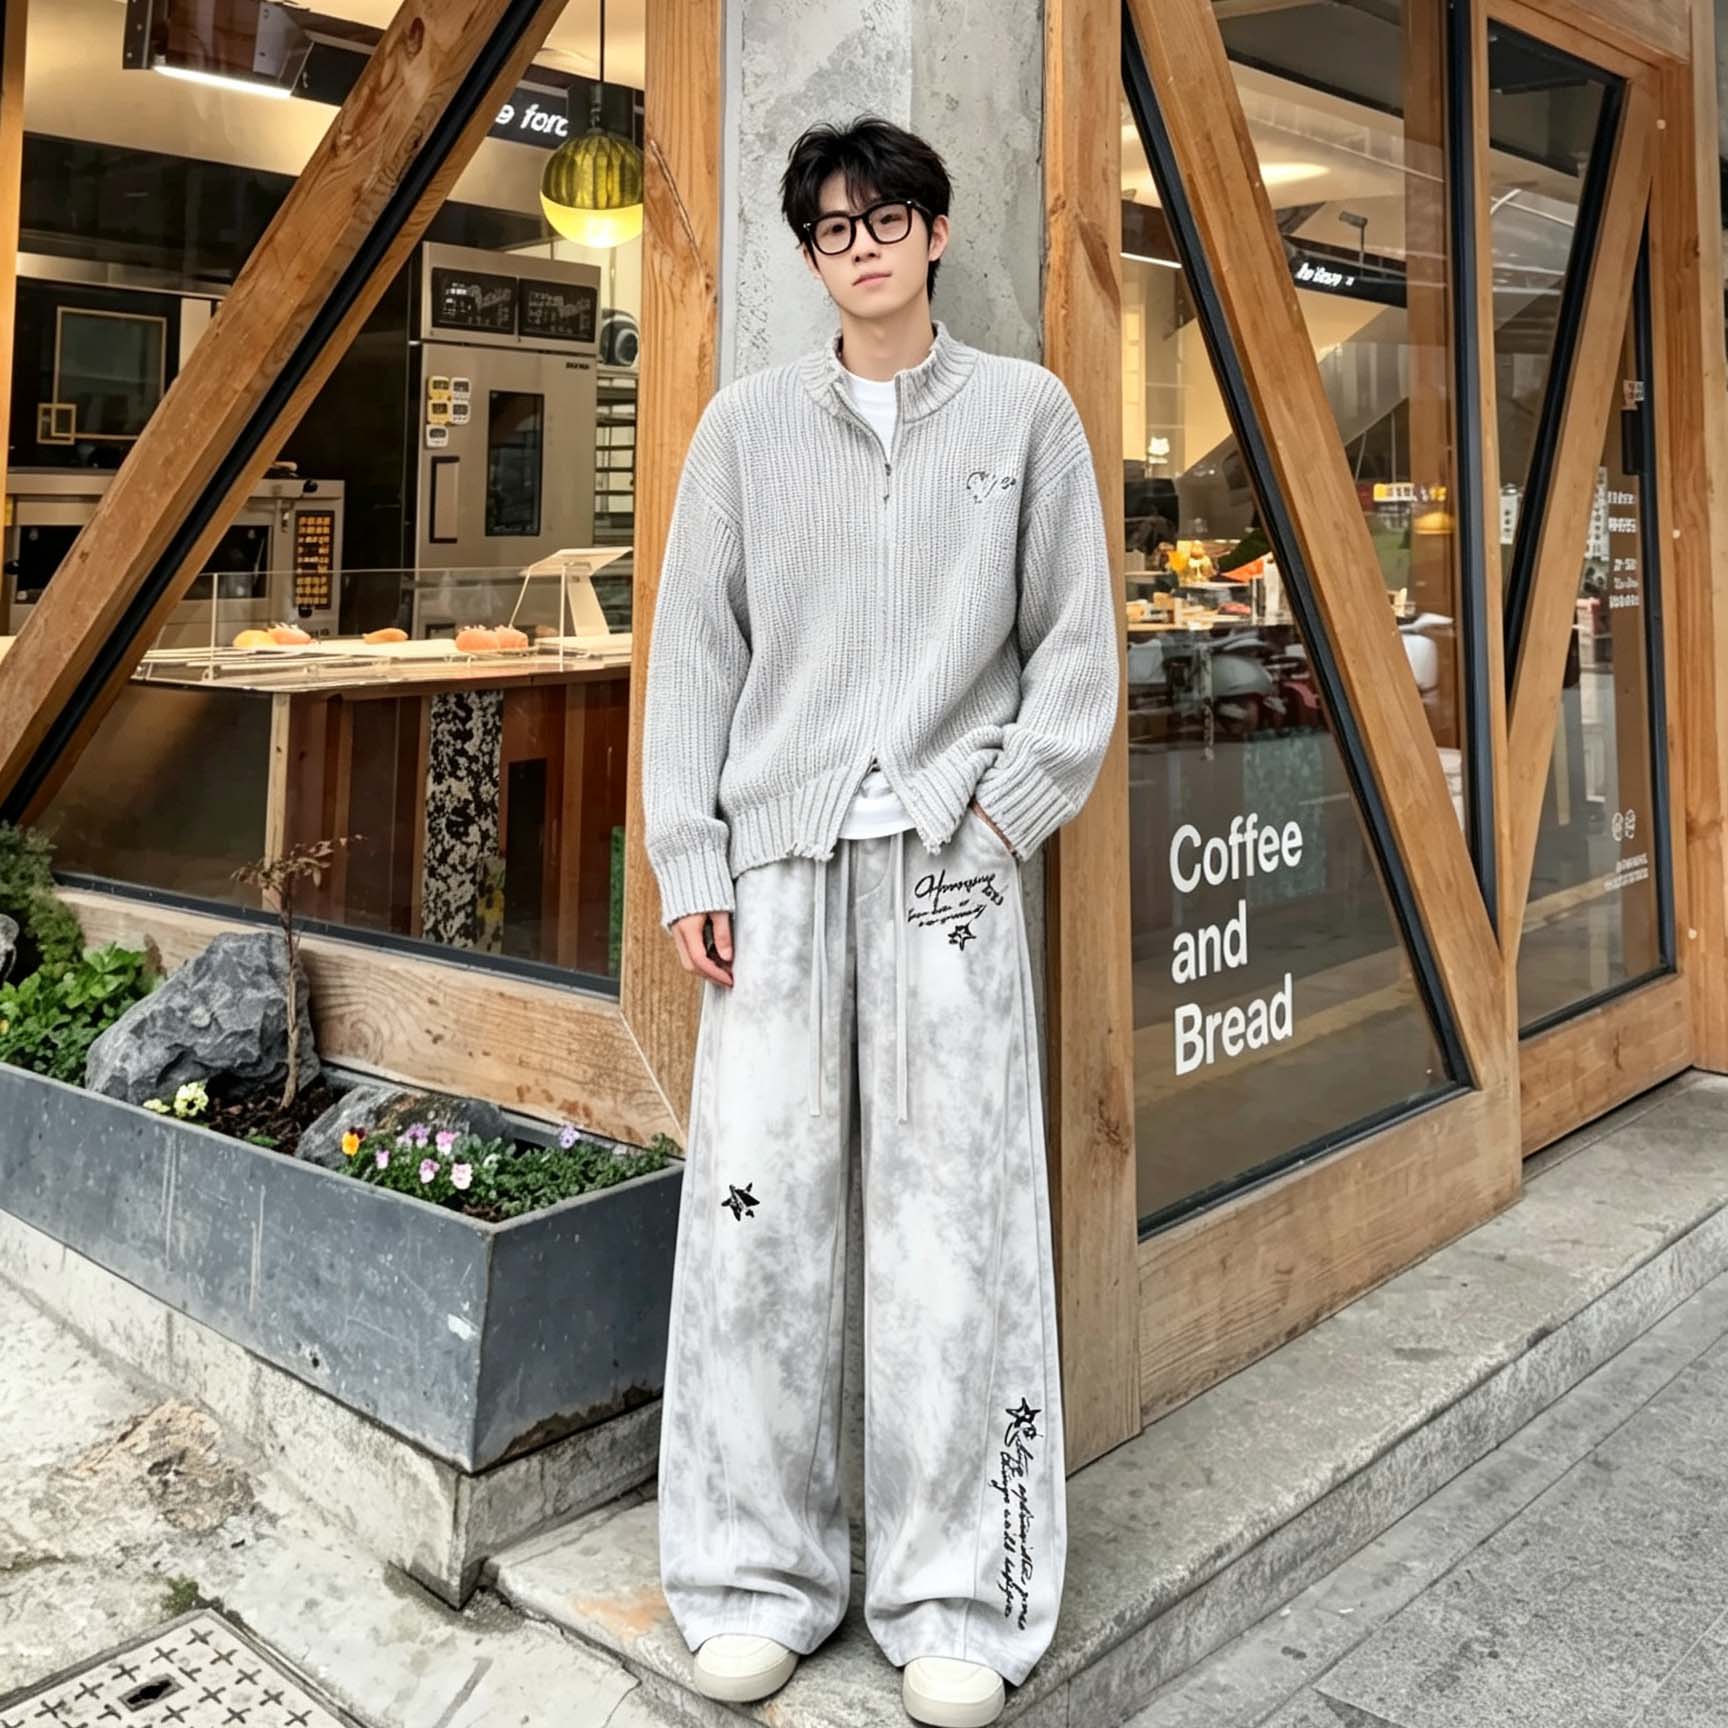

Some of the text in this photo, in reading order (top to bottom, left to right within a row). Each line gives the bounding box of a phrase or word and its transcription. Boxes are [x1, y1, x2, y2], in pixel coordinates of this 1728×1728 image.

[1169, 812, 1304, 894] Coffee
[1171, 899, 1248, 984] and
[1174, 972, 1293, 1076] Bread
